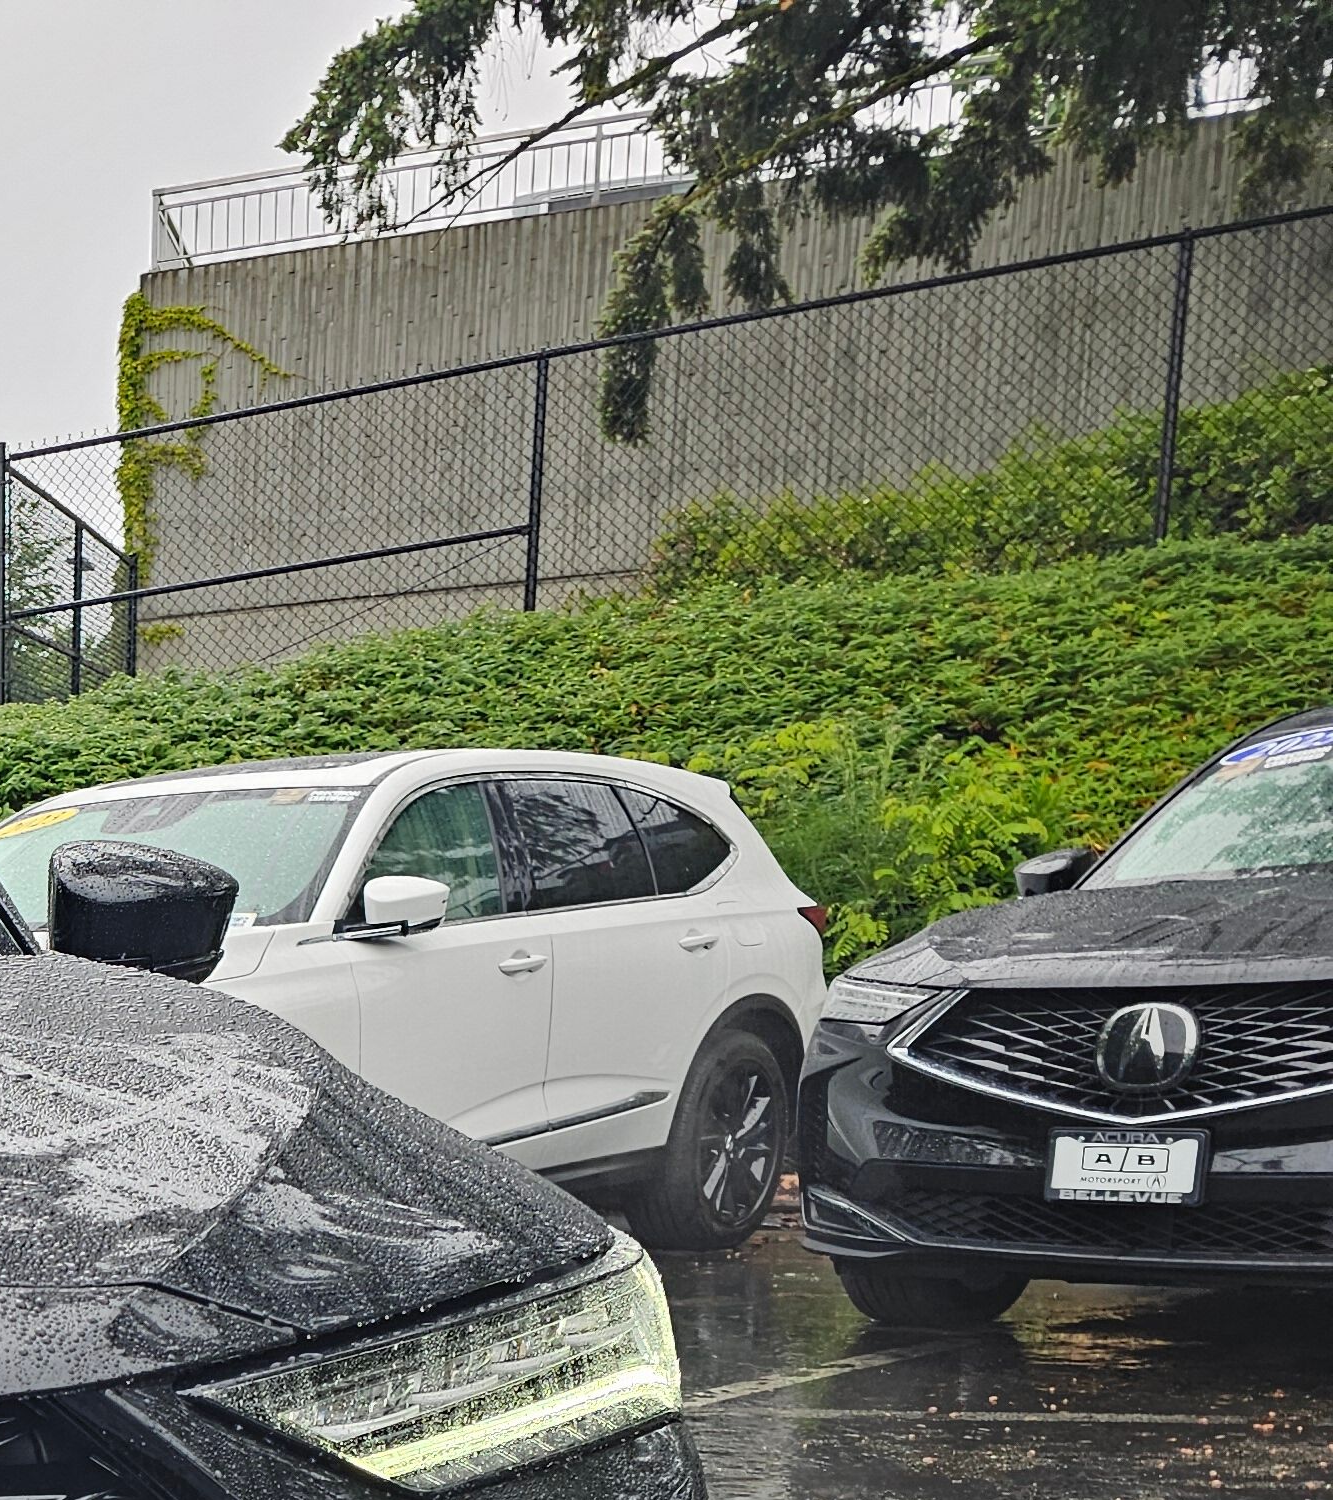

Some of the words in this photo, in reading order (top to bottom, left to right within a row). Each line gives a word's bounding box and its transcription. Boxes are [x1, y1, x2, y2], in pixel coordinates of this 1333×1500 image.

[1091, 1132, 1160, 1143] ACURA
[1079, 1176, 1142, 1185] MOTORSPORT
[1059, 1189, 1183, 1204] BELLEVUE
